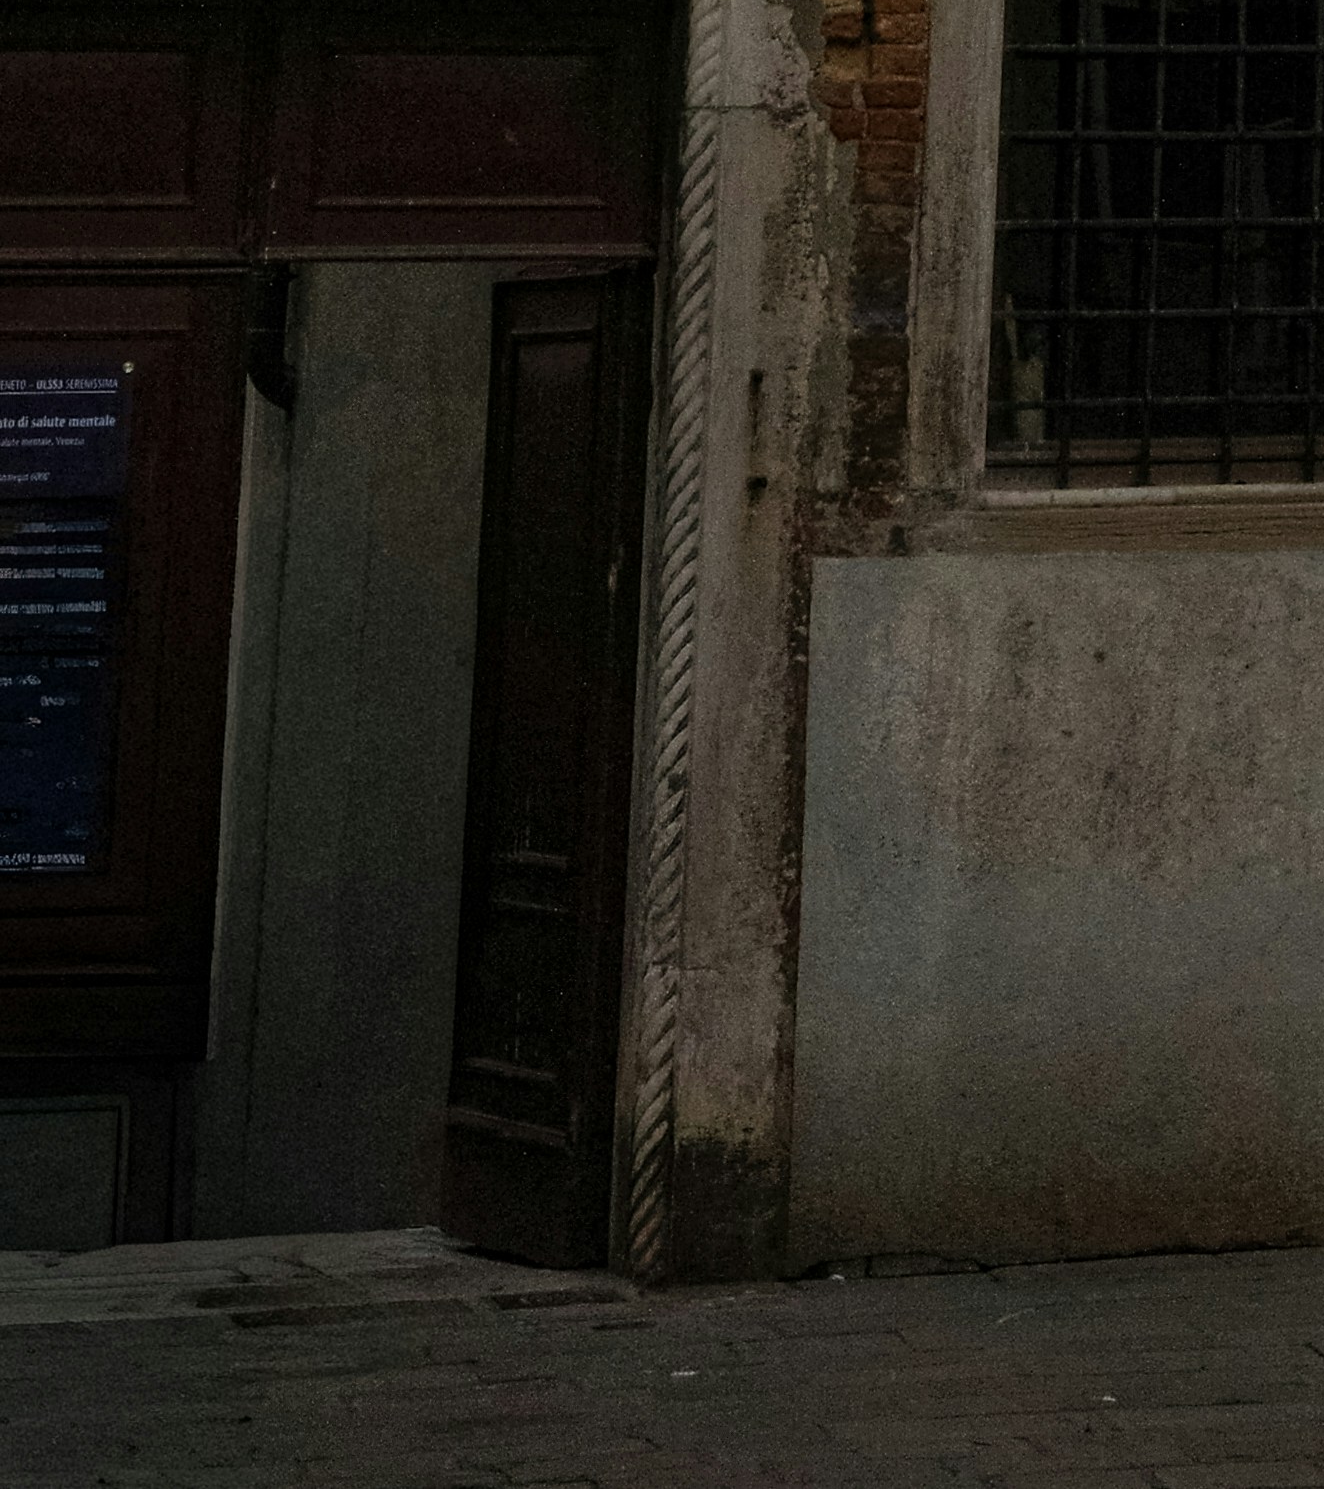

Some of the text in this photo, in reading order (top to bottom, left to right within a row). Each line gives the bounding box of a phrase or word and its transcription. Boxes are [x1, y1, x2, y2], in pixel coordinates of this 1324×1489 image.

[0, 379, 26, 390] ENETO
[65, 378, 118, 389] SERENISSIMA
[18, 415, 29, 428] di
[31, 415, 66, 428] salute
[68, 414, 116, 427] mentale
